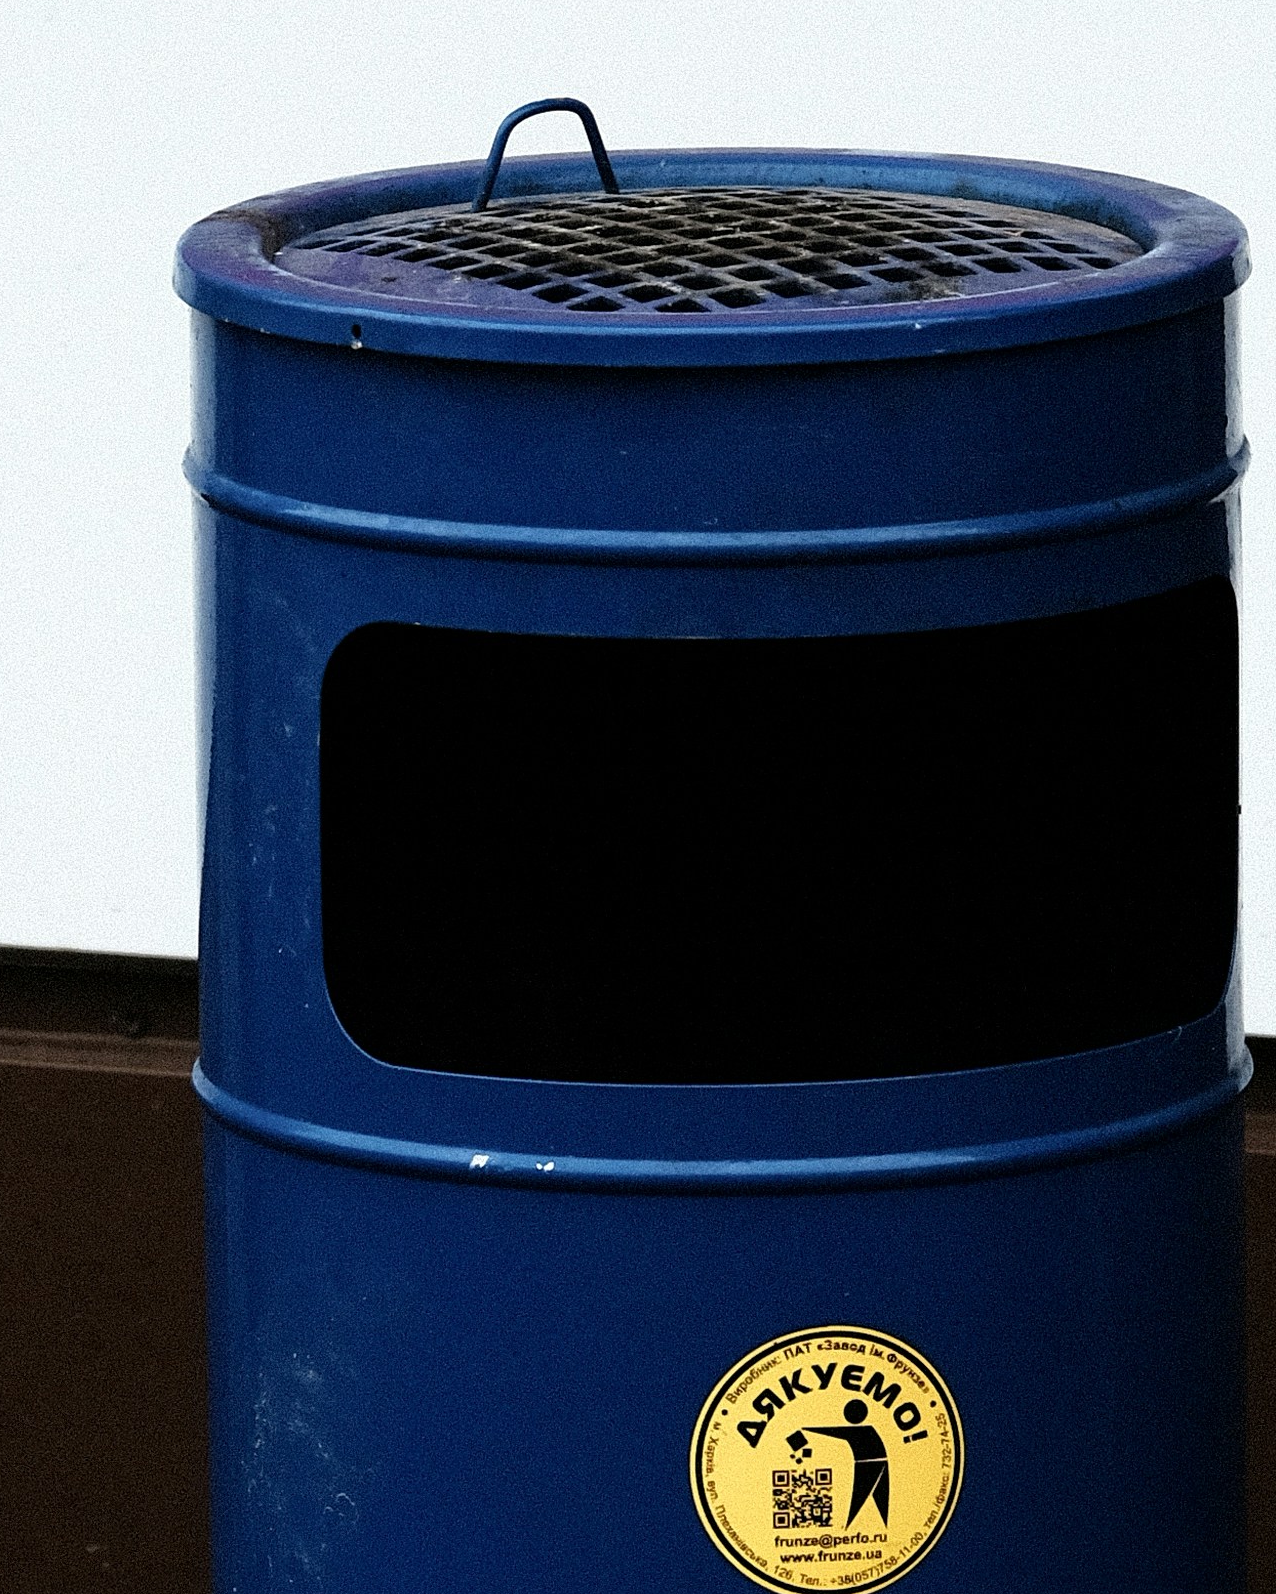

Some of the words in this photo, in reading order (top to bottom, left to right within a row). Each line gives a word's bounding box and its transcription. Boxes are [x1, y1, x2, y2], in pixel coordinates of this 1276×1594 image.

[725, 1355, 782, 1404] Виробник:
[783, 1342, 812, 1360] ПАТ
[817, 1339, 866, 1355] «Завод
[736, 1362, 928, 1449] ДЯКУЄМО!
[935, 1413, 953, 1469] 732-74-25
[774, 1533, 888, 1548] frunze@perfo.ru
[780, 1550, 882, 1563] www.frunze.ua
